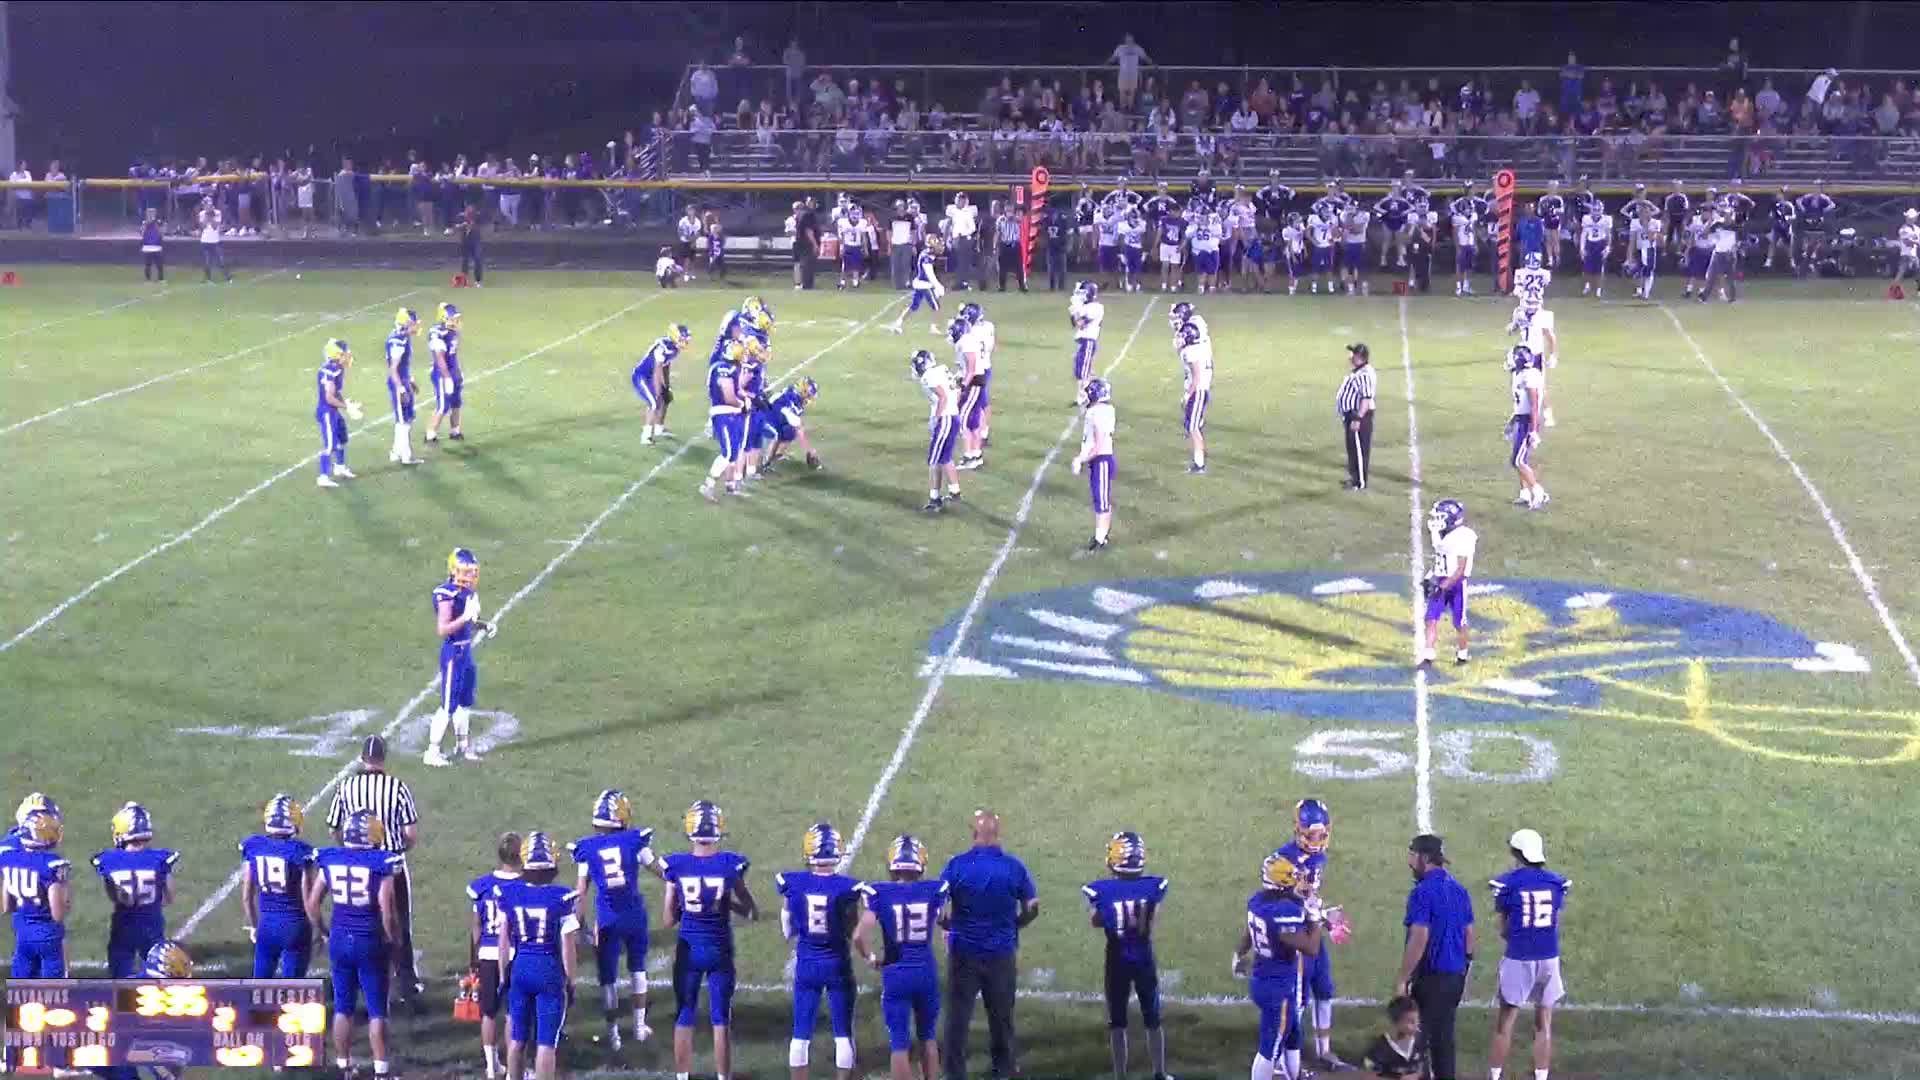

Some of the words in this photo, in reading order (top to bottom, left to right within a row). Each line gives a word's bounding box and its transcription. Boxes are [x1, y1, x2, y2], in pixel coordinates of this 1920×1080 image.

[1292, 729, 1558, 784] 50
[255, 856, 287, 893] 19
[514, 906, 548, 942] 17
